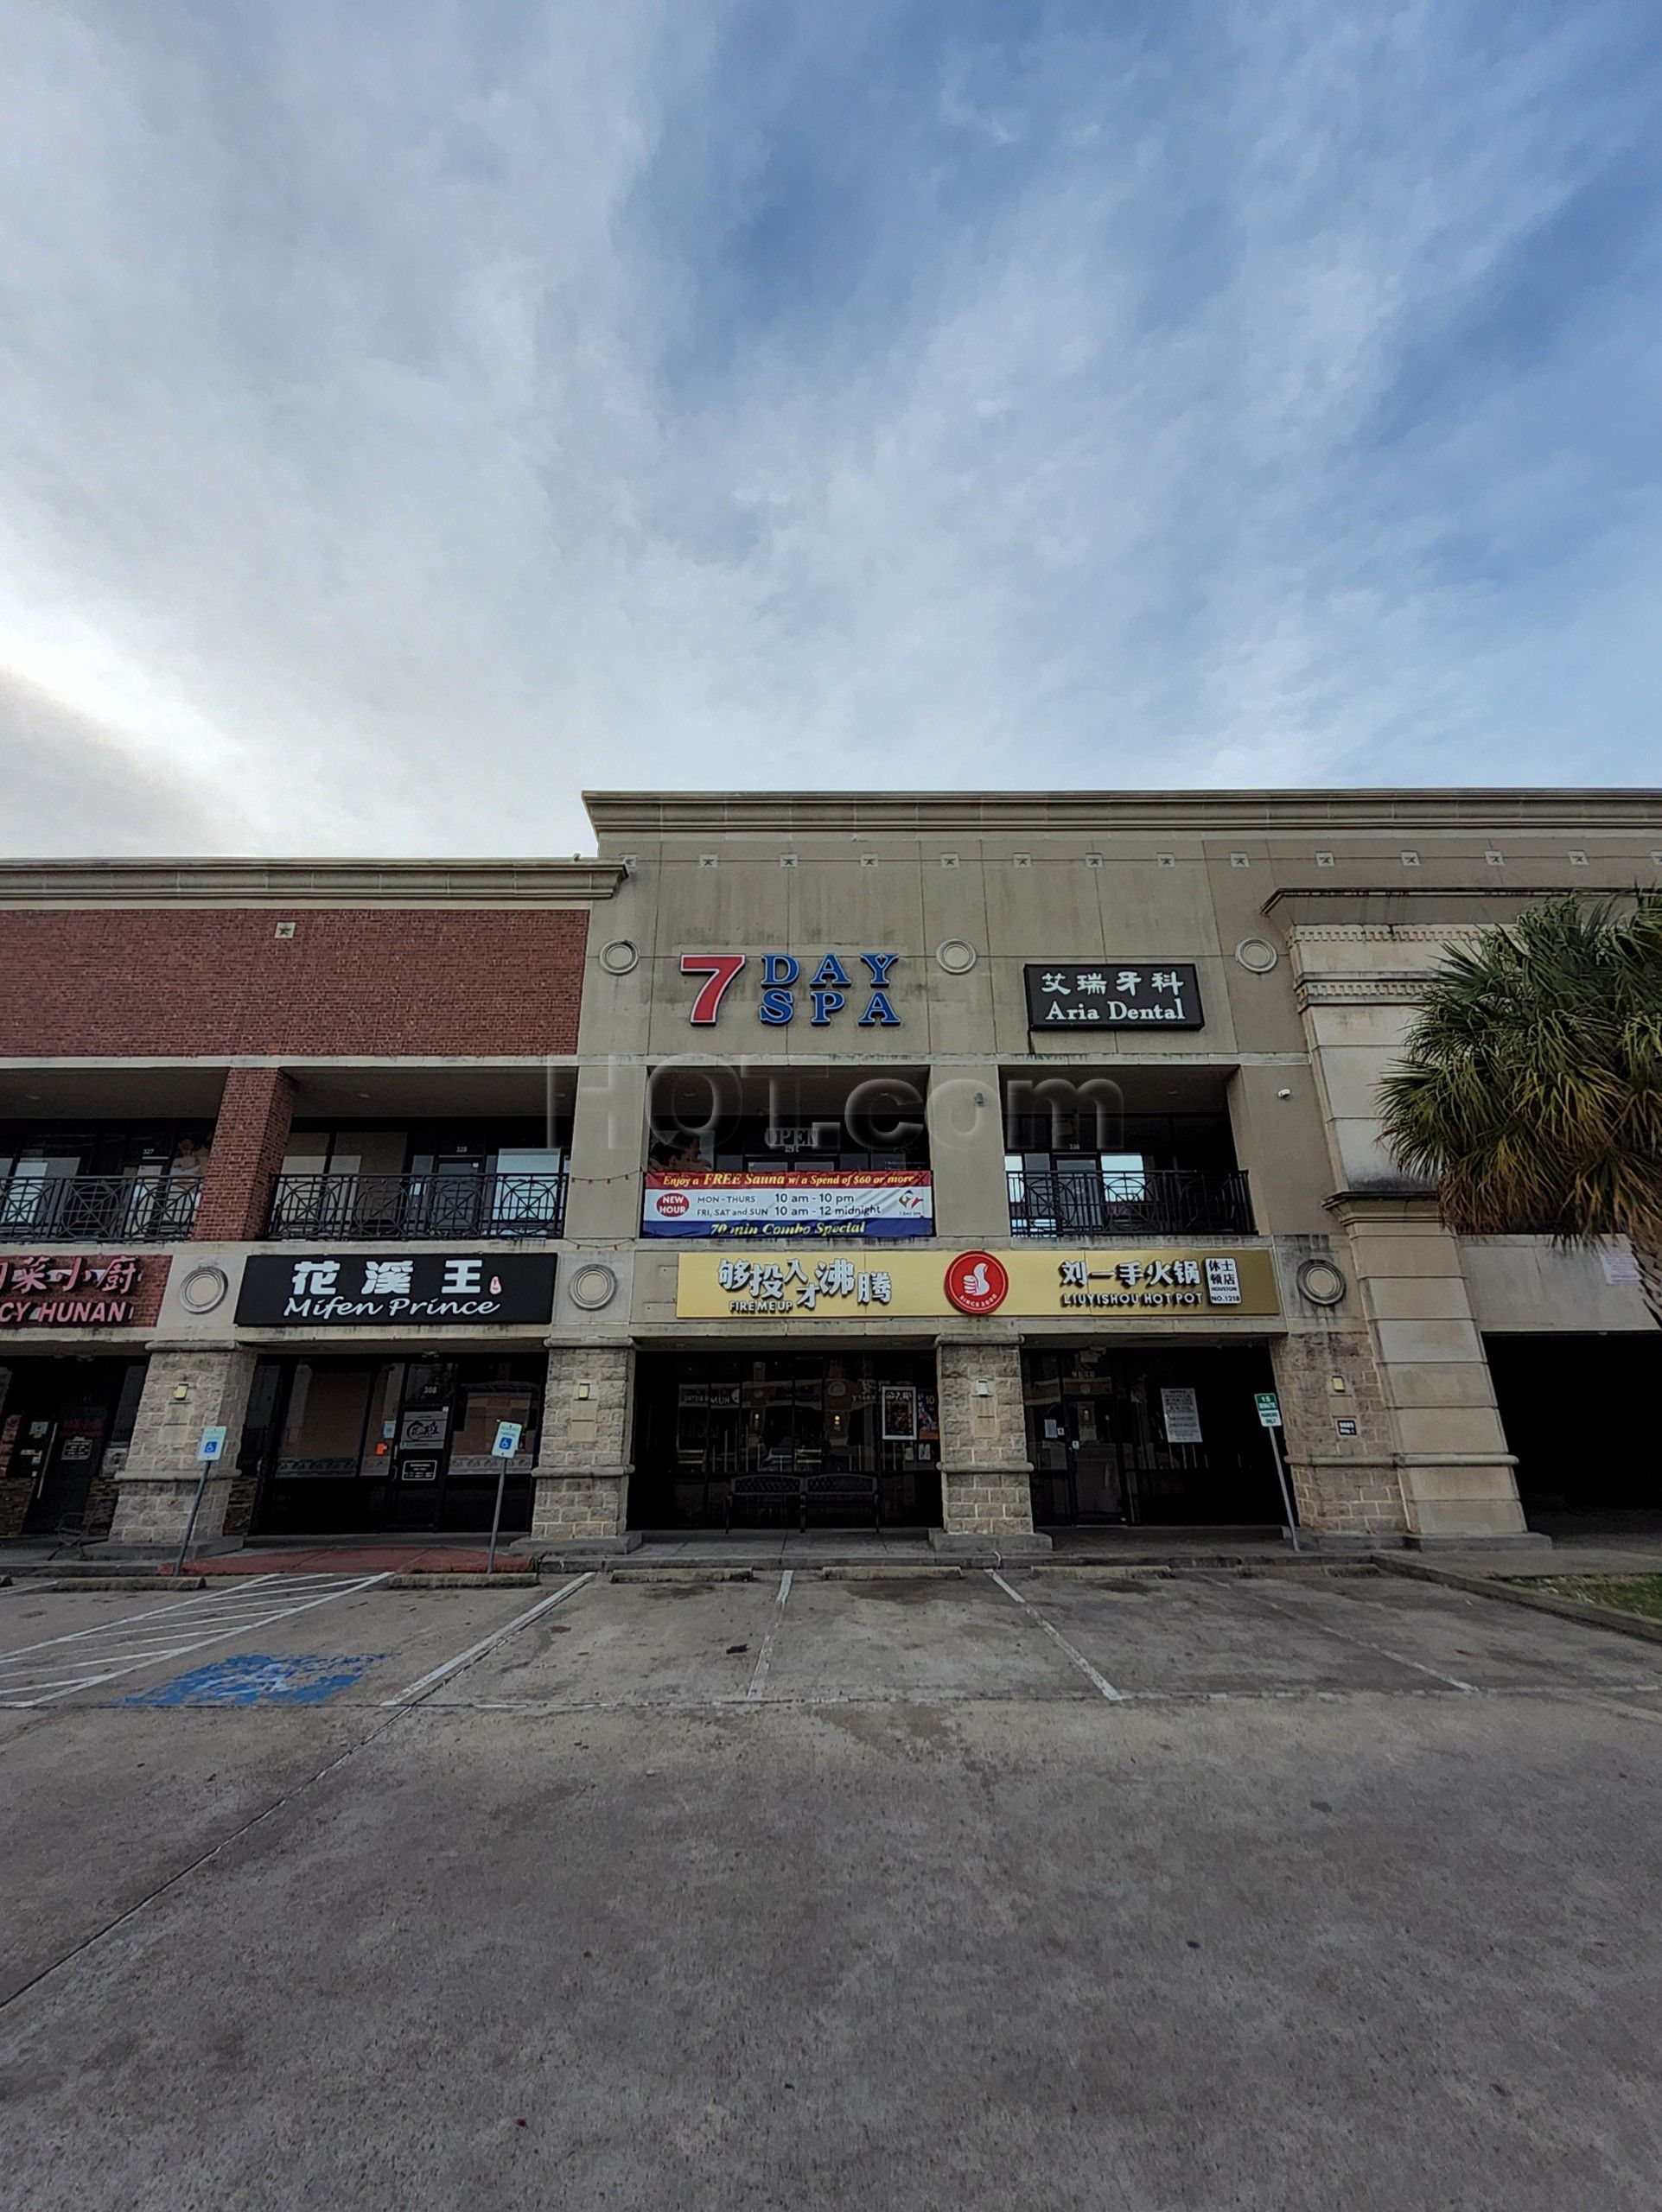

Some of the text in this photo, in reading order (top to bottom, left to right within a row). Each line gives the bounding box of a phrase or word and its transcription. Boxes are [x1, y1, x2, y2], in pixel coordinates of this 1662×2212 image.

[679, 953, 900, 1026] 7 DAY
[1041, 971, 1184, 996] 艾瑞牙科
[759, 988, 901, 1026] SPA
[1045, 998, 1186, 1020] Aria Dental
[764, 1127, 819, 1147] OPEN
[663, 1175, 691, 1187] Enjoy
[692, 1177, 699, 1185] a
[704, 1173, 742, 1185] FREE
[744, 1174, 785, 1185] Sauna
[788, 1176, 799, 1185] w/
[810, 1175, 843, 1186] Spend
[842, 1175, 852, 1186] of
[853, 1175, 871, 1185] $60
[775, 1193, 788, 1203] 10
[819, 1193, 832, 1202] 10
[836, 1195, 855, 1206] pm
[697, 1209, 712, 1217] FRI,
[775, 1206, 788, 1216] 10
[819, 1206, 832, 1216] 12
[835, 1205, 882, 1217] midnight
[710, 1221, 865, 1236] 70 min Combo Special
[292, 1260, 483, 1295] 花溪王
[1062, 1260, 1200, 1287] 刘一手火锅
[283, 1296, 500, 1319] Mifen Prince
[729, 1300, 793, 1313] FIRE ME UP
[1063, 1293, 1203, 1305] LIUYISHOU HOT POT
[38, 1301, 126, 1323] HUNAN
